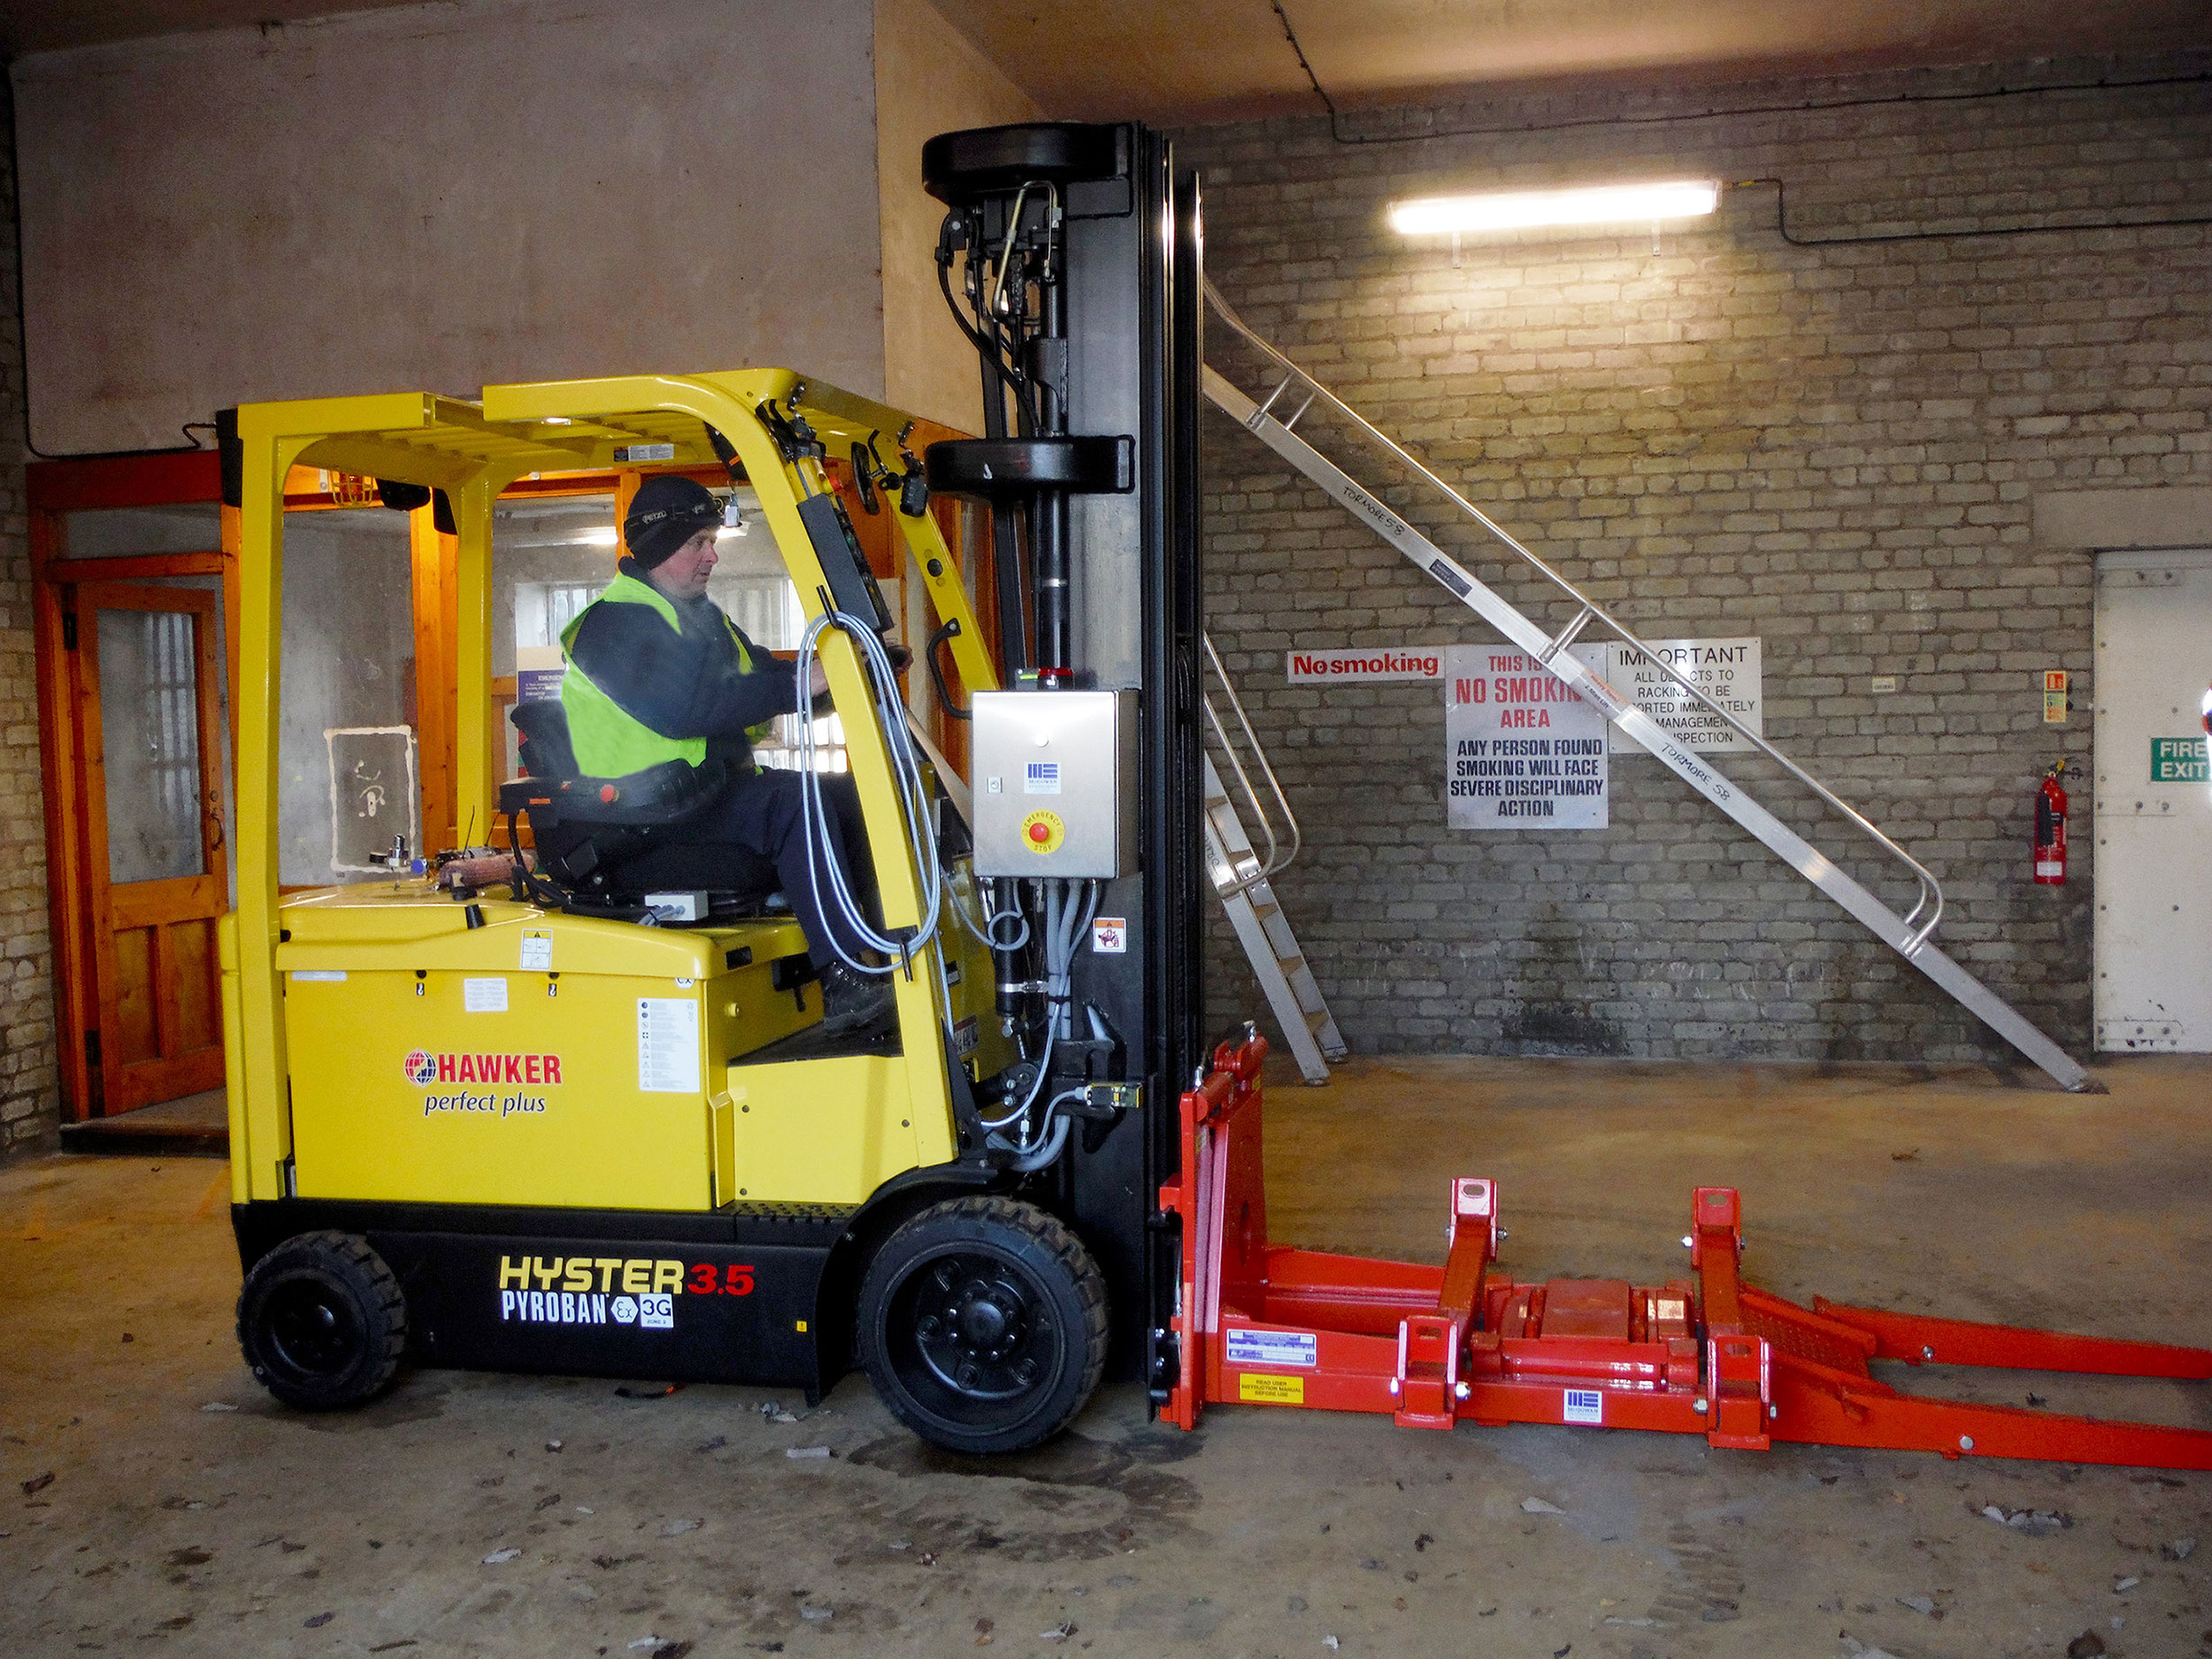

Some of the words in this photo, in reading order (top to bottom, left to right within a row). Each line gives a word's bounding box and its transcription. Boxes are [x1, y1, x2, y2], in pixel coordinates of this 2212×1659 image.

[1330, 653, 1439, 676] smoking
[1488, 656, 1523, 672] THIS
[1620, 647, 1747, 665] IMORTANT
[1634, 672, 1655, 682] ALL
[1718, 670, 1734, 680] TO
[1456, 678, 1486, 704] NO
[1494, 677, 1582, 703] SMOKIN
[1716, 685, 1731, 696] BE
[1632, 703, 1674, 713] ORTED
[1501, 709, 1550, 728] AREA
[1655, 717, 1728, 728] MANAGEMEN
[1674, 733, 1732, 743] SPECTION
[1457, 740, 1487, 757] ANY
[1493, 740, 1549, 757] PERSON
[1554, 739, 1602, 756] FOUND
[2161, 741, 2208, 757] FIRE
[1456, 760, 1524, 777] SMOKING
[1528, 760, 1562, 776] WILL
[1564, 759, 1599, 776] FACE
[1662, 742, 1712, 786] TORMORE
[2161, 762, 2208, 778] EXIT
[1450, 780, 1502, 796] SEVERE
[1504, 780, 1604, 796] DISCIPLINARY
[1498, 800, 1554, 817] ACTION
[1025, 811, 1061, 827] EMERGENCY
[439, 1054, 562, 1084] HAWKER
[425, 1091, 496, 1117] perfect
[503, 1092, 546, 1118] plus
[499, 1256, 685, 1294] HYSTER
[687, 1263, 755, 1296] 3.5
[502, 1290, 607, 1325] PYROBAN
[642, 1299, 672, 1317] 3G
